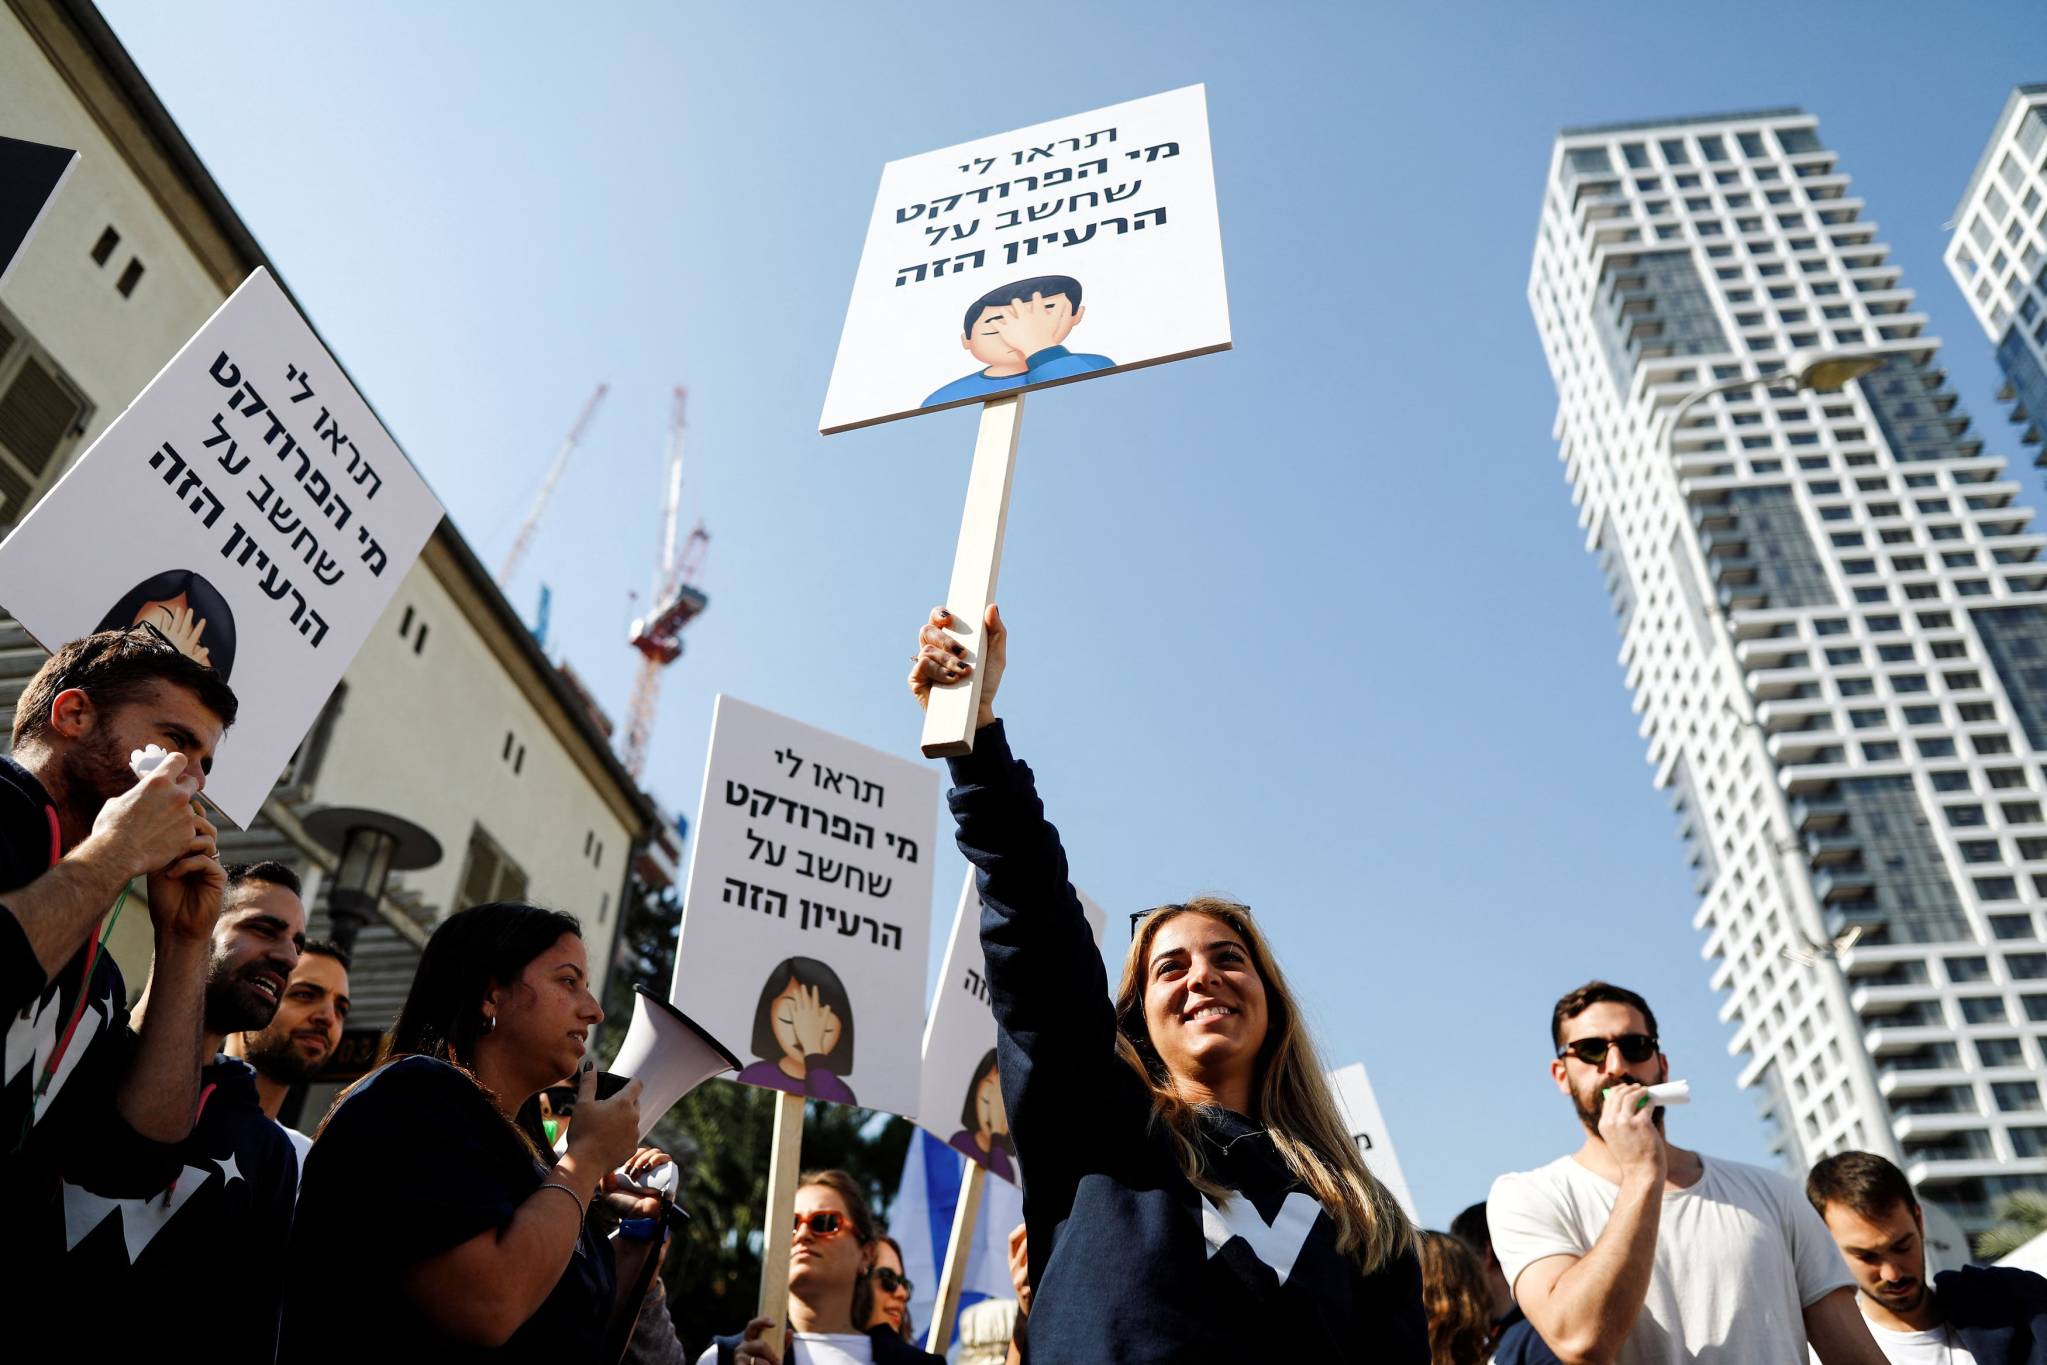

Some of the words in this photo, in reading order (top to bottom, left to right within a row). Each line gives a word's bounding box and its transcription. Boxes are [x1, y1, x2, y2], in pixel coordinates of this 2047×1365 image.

[958, 156, 997, 175] לי
[1011, 127, 1117, 166] תראו
[1125, 142, 1180, 163] מי
[896, 157, 1108, 224] הפרודקט
[995, 179, 1142, 231] שחשב
[925, 218, 980, 247] על
[1003, 206, 1167, 265] הרעיון
[895, 249, 986, 287] הזה
[285, 363, 315, 404] לי
[202, 412, 251, 476] על
[208, 350, 353, 531] הפרודקט
[312, 405, 383, 500] תראו
[148, 441, 226, 530] הזה
[246, 473, 345, 586] שחשב
[357, 525, 388, 578] מי
[220, 521, 330, 649] הרעיון
[774, 748, 804, 779] לי
[812, 763, 885, 809] תראו
[725, 779, 875, 850] הפרודקט
[746, 827, 787, 868] על
[885, 831, 919, 864] מי
[722, 876, 788, 919] הזה
[795, 849, 893, 899] שחשב
[799, 898, 903, 951] הרעיון
[963, 968, 991, 1007] זה
